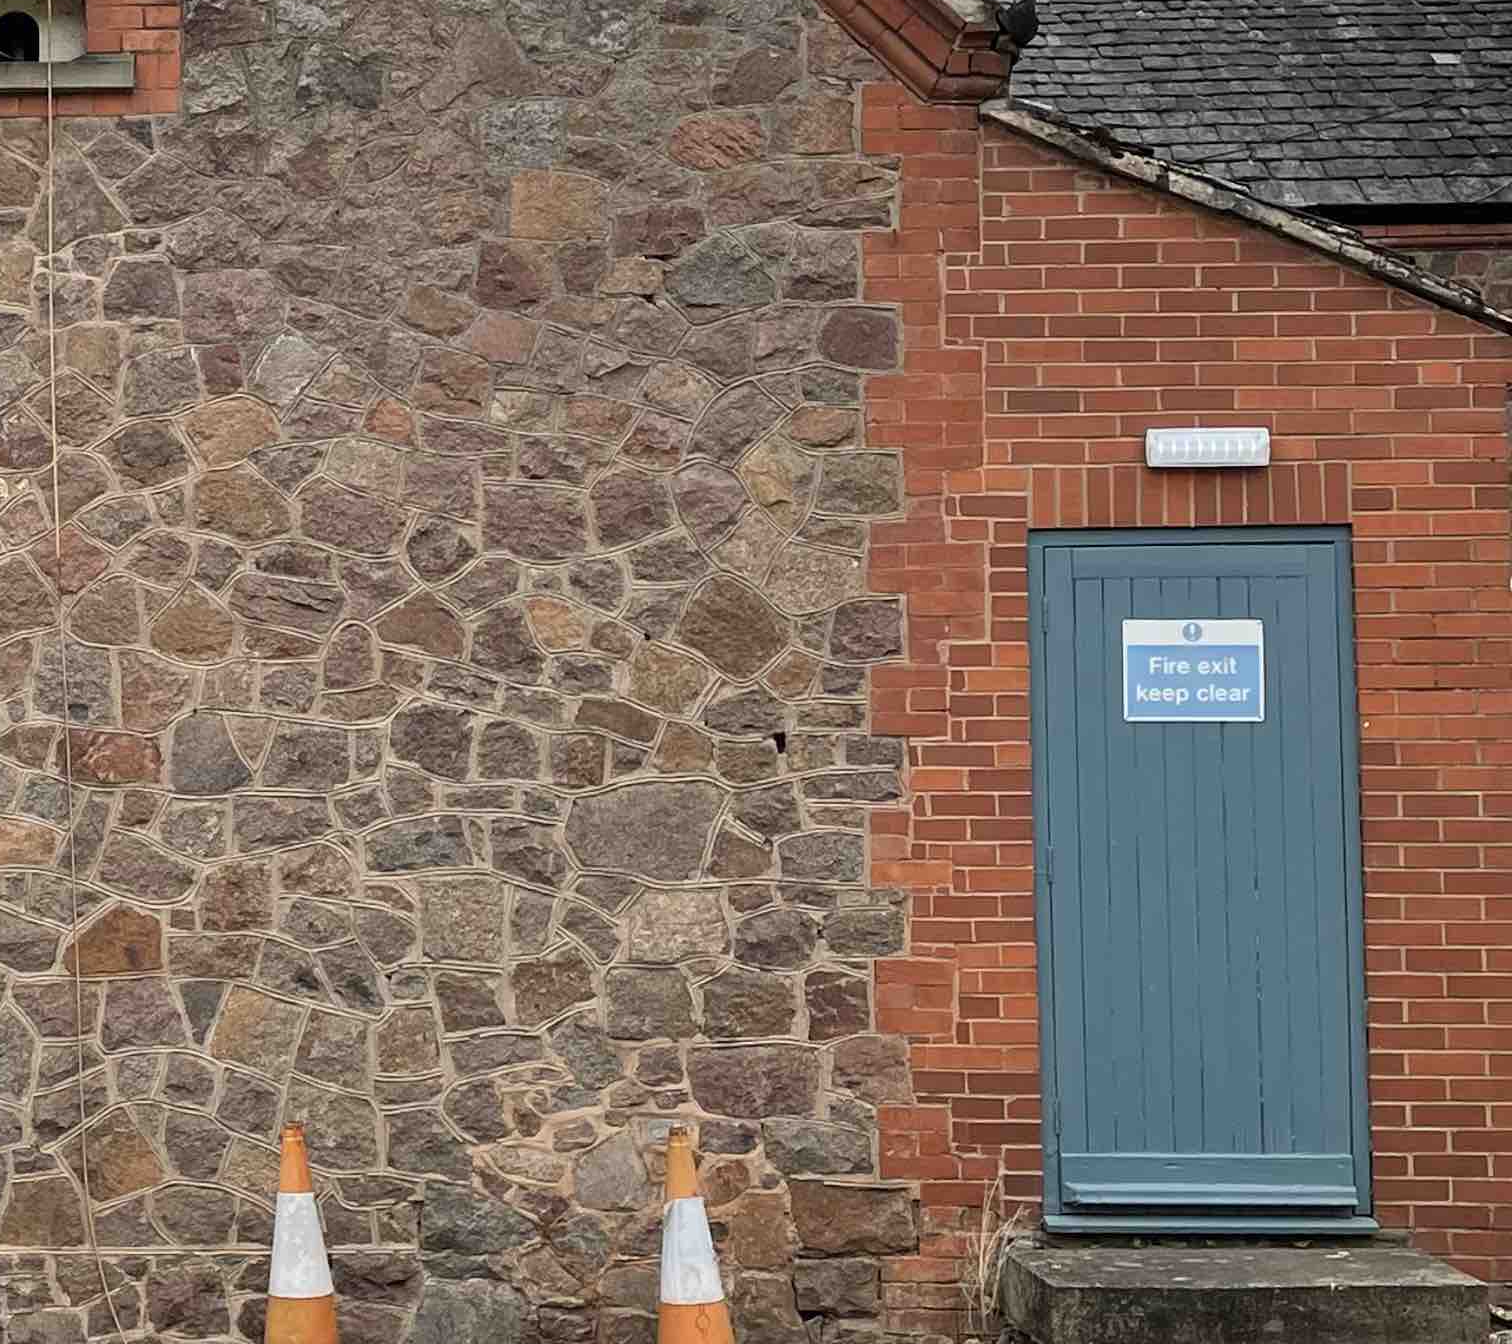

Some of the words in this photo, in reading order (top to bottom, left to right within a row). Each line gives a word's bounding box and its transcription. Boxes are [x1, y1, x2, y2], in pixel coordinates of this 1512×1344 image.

[1149, 656, 1192, 674] Fire
[1197, 656, 1237, 674] exit
[1136, 683, 1189, 705] keep
[1196, 683, 1251, 702] clear
